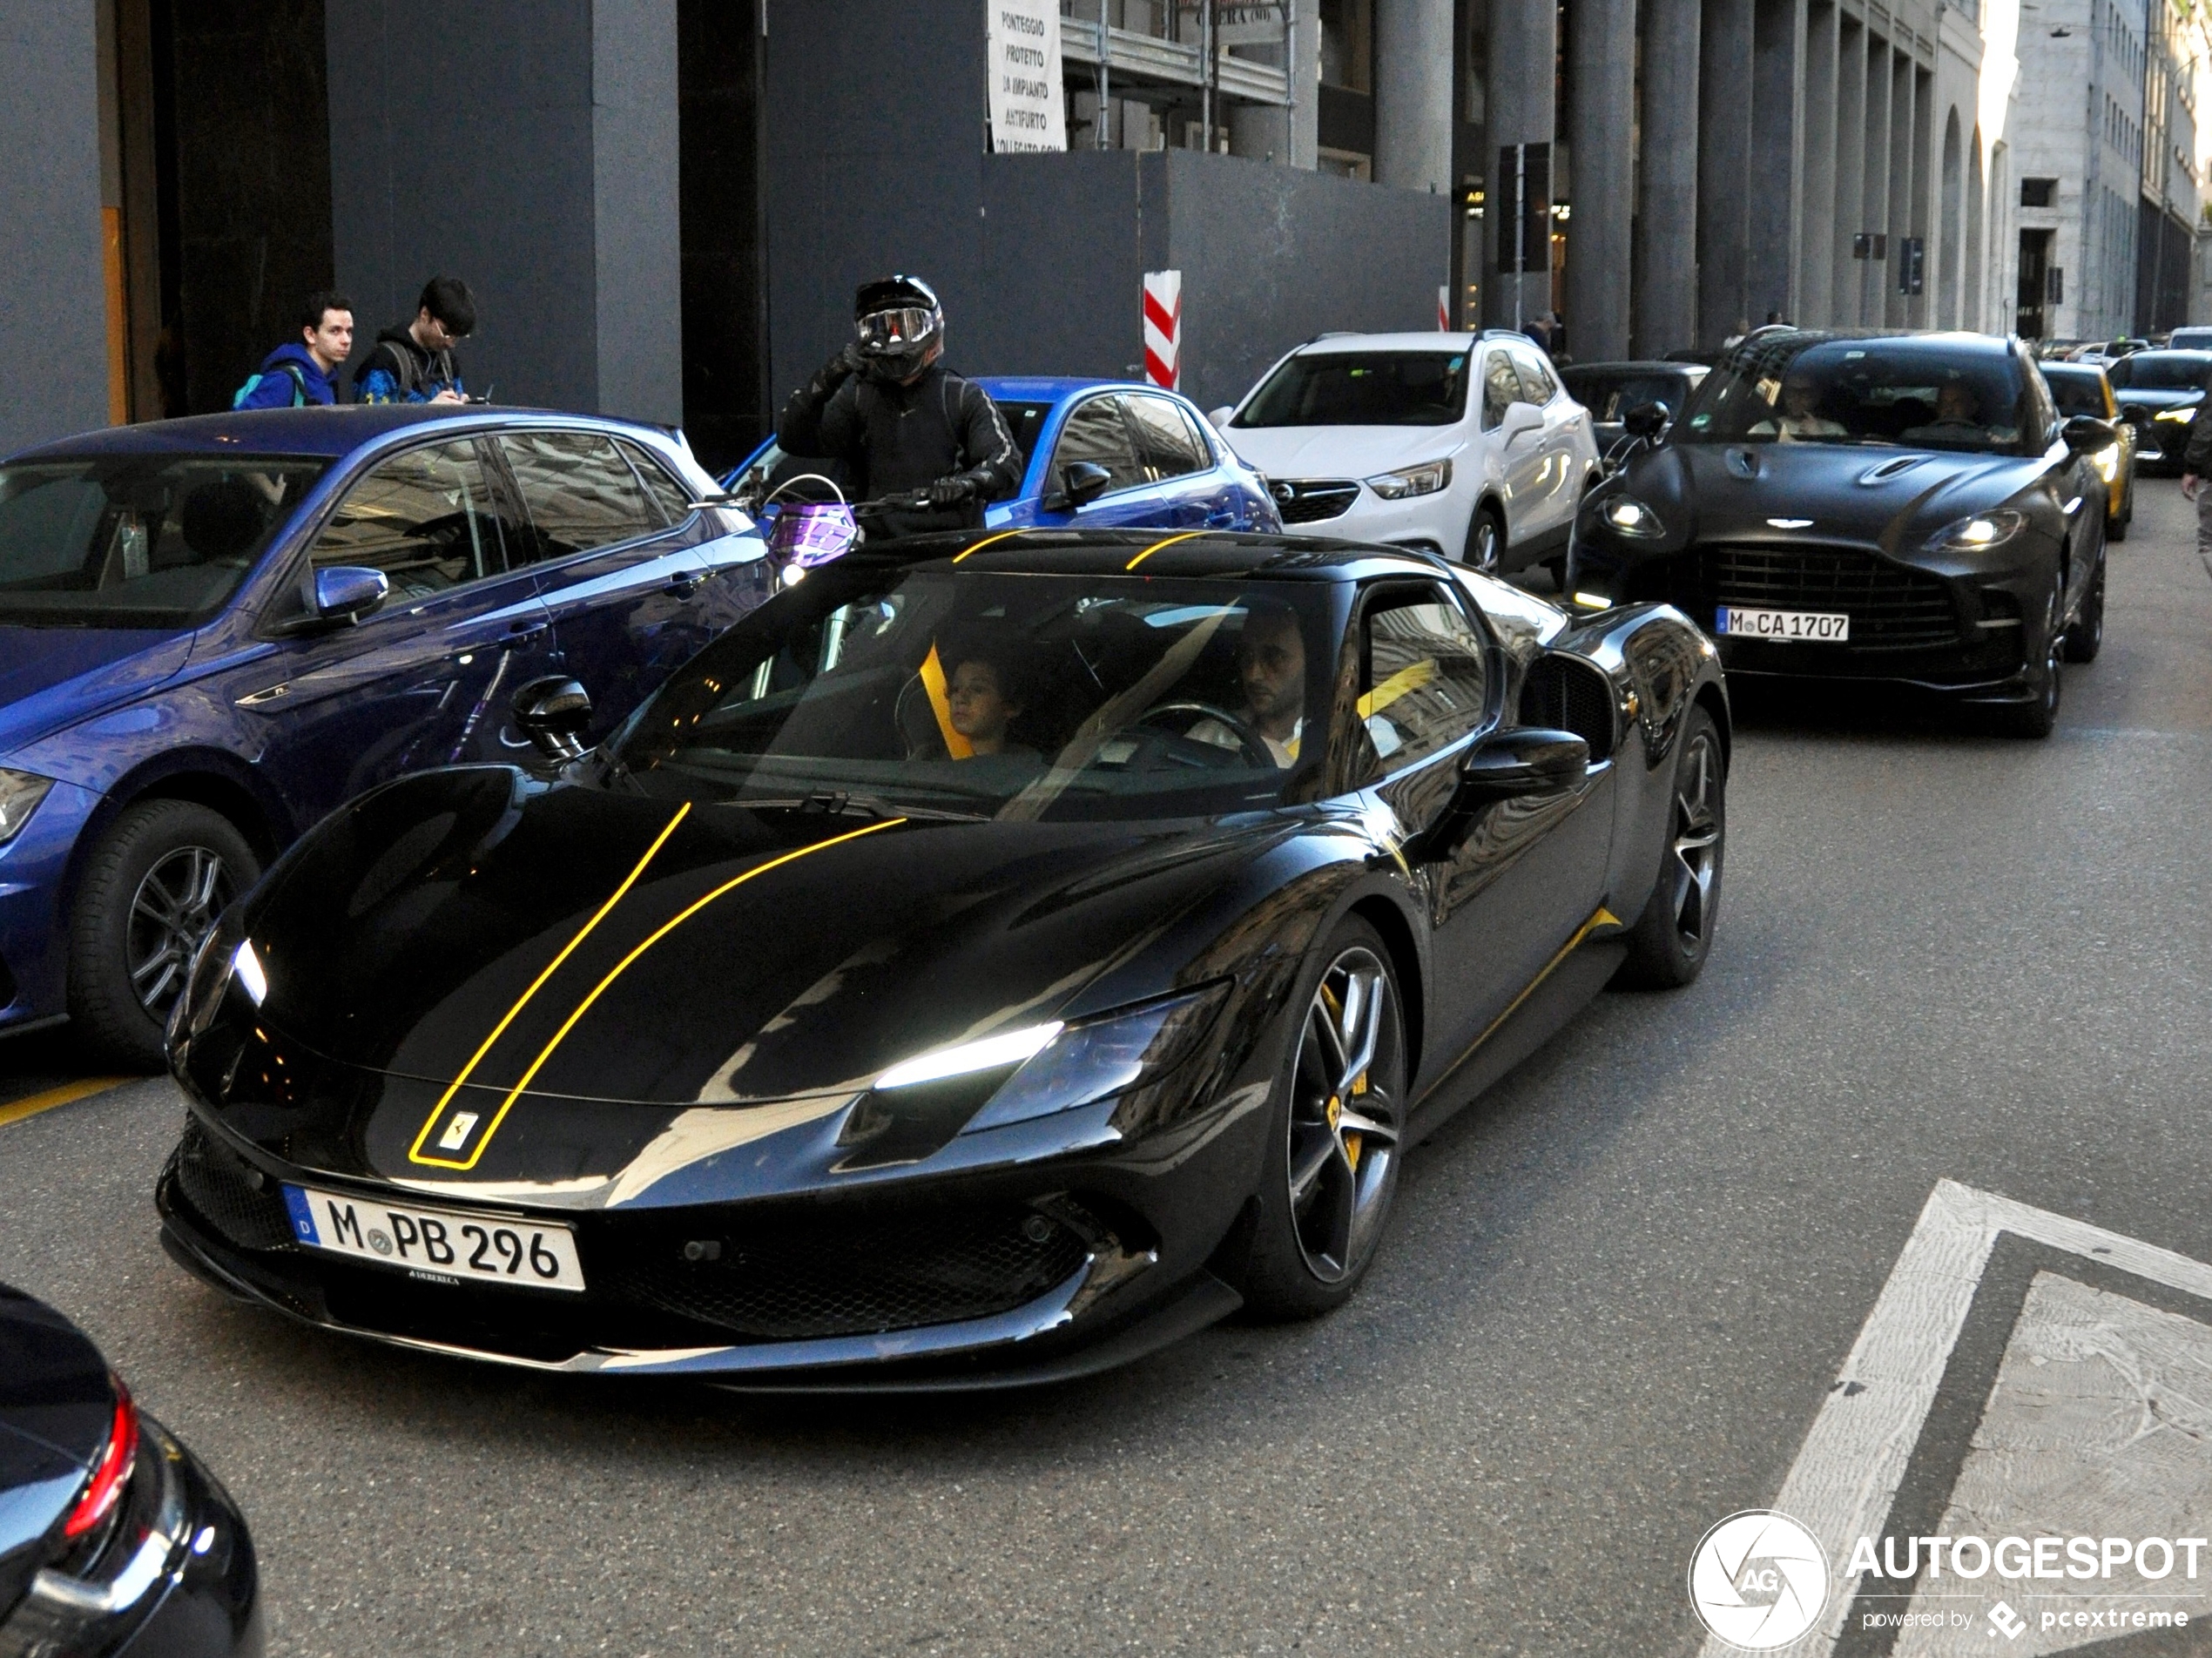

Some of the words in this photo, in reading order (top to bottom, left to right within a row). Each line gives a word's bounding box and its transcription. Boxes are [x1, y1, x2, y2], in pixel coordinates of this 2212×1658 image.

[1001, 11, 1044, 37] PONTEGGIO
[1006, 44, 1044, 68] PROTETTO
[1012, 77, 1049, 100] IMPIANTO
[1005, 107, 1047, 130] ANTIFURTO
[1730, 611, 1743, 632] M
[1757, 614, 1785, 635] CA
[1791, 616, 1846, 637] 1707
[299, 1220, 311, 1234] D
[327, 1200, 364, 1249] M
[387, 1211, 455, 1264] PB
[462, 1224, 559, 1279] 296
